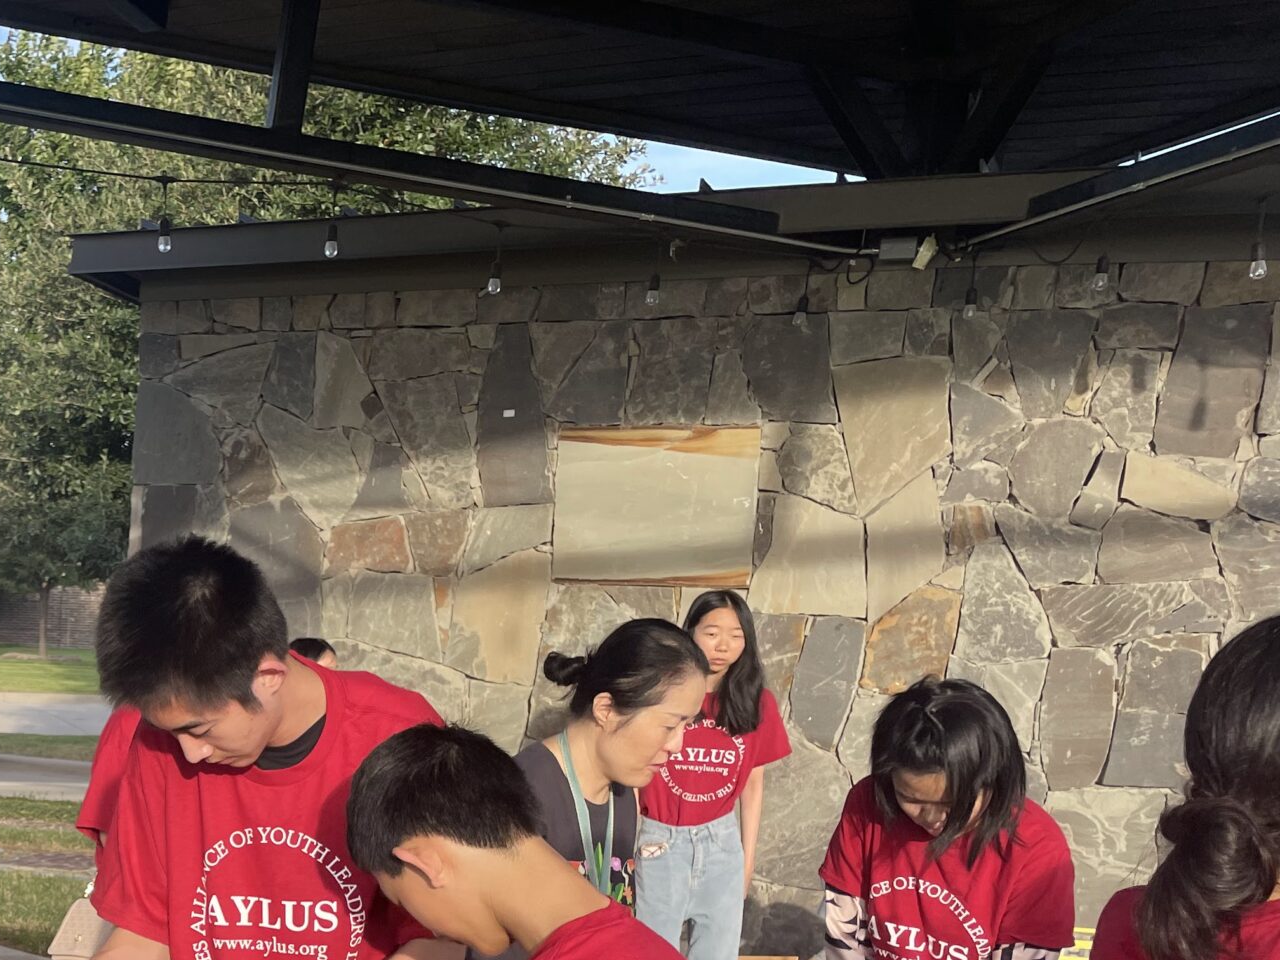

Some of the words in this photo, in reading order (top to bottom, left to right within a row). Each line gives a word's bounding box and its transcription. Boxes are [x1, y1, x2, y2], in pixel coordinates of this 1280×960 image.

[190, 840, 228, 936] ALLICE
[229, 827, 253, 849] OF
[257, 826, 330, 863] YOUTH
[325, 856, 366, 948] LEADERS
[918, 879, 970, 922] YOUTH
[208, 895, 338, 932] AYLUS
